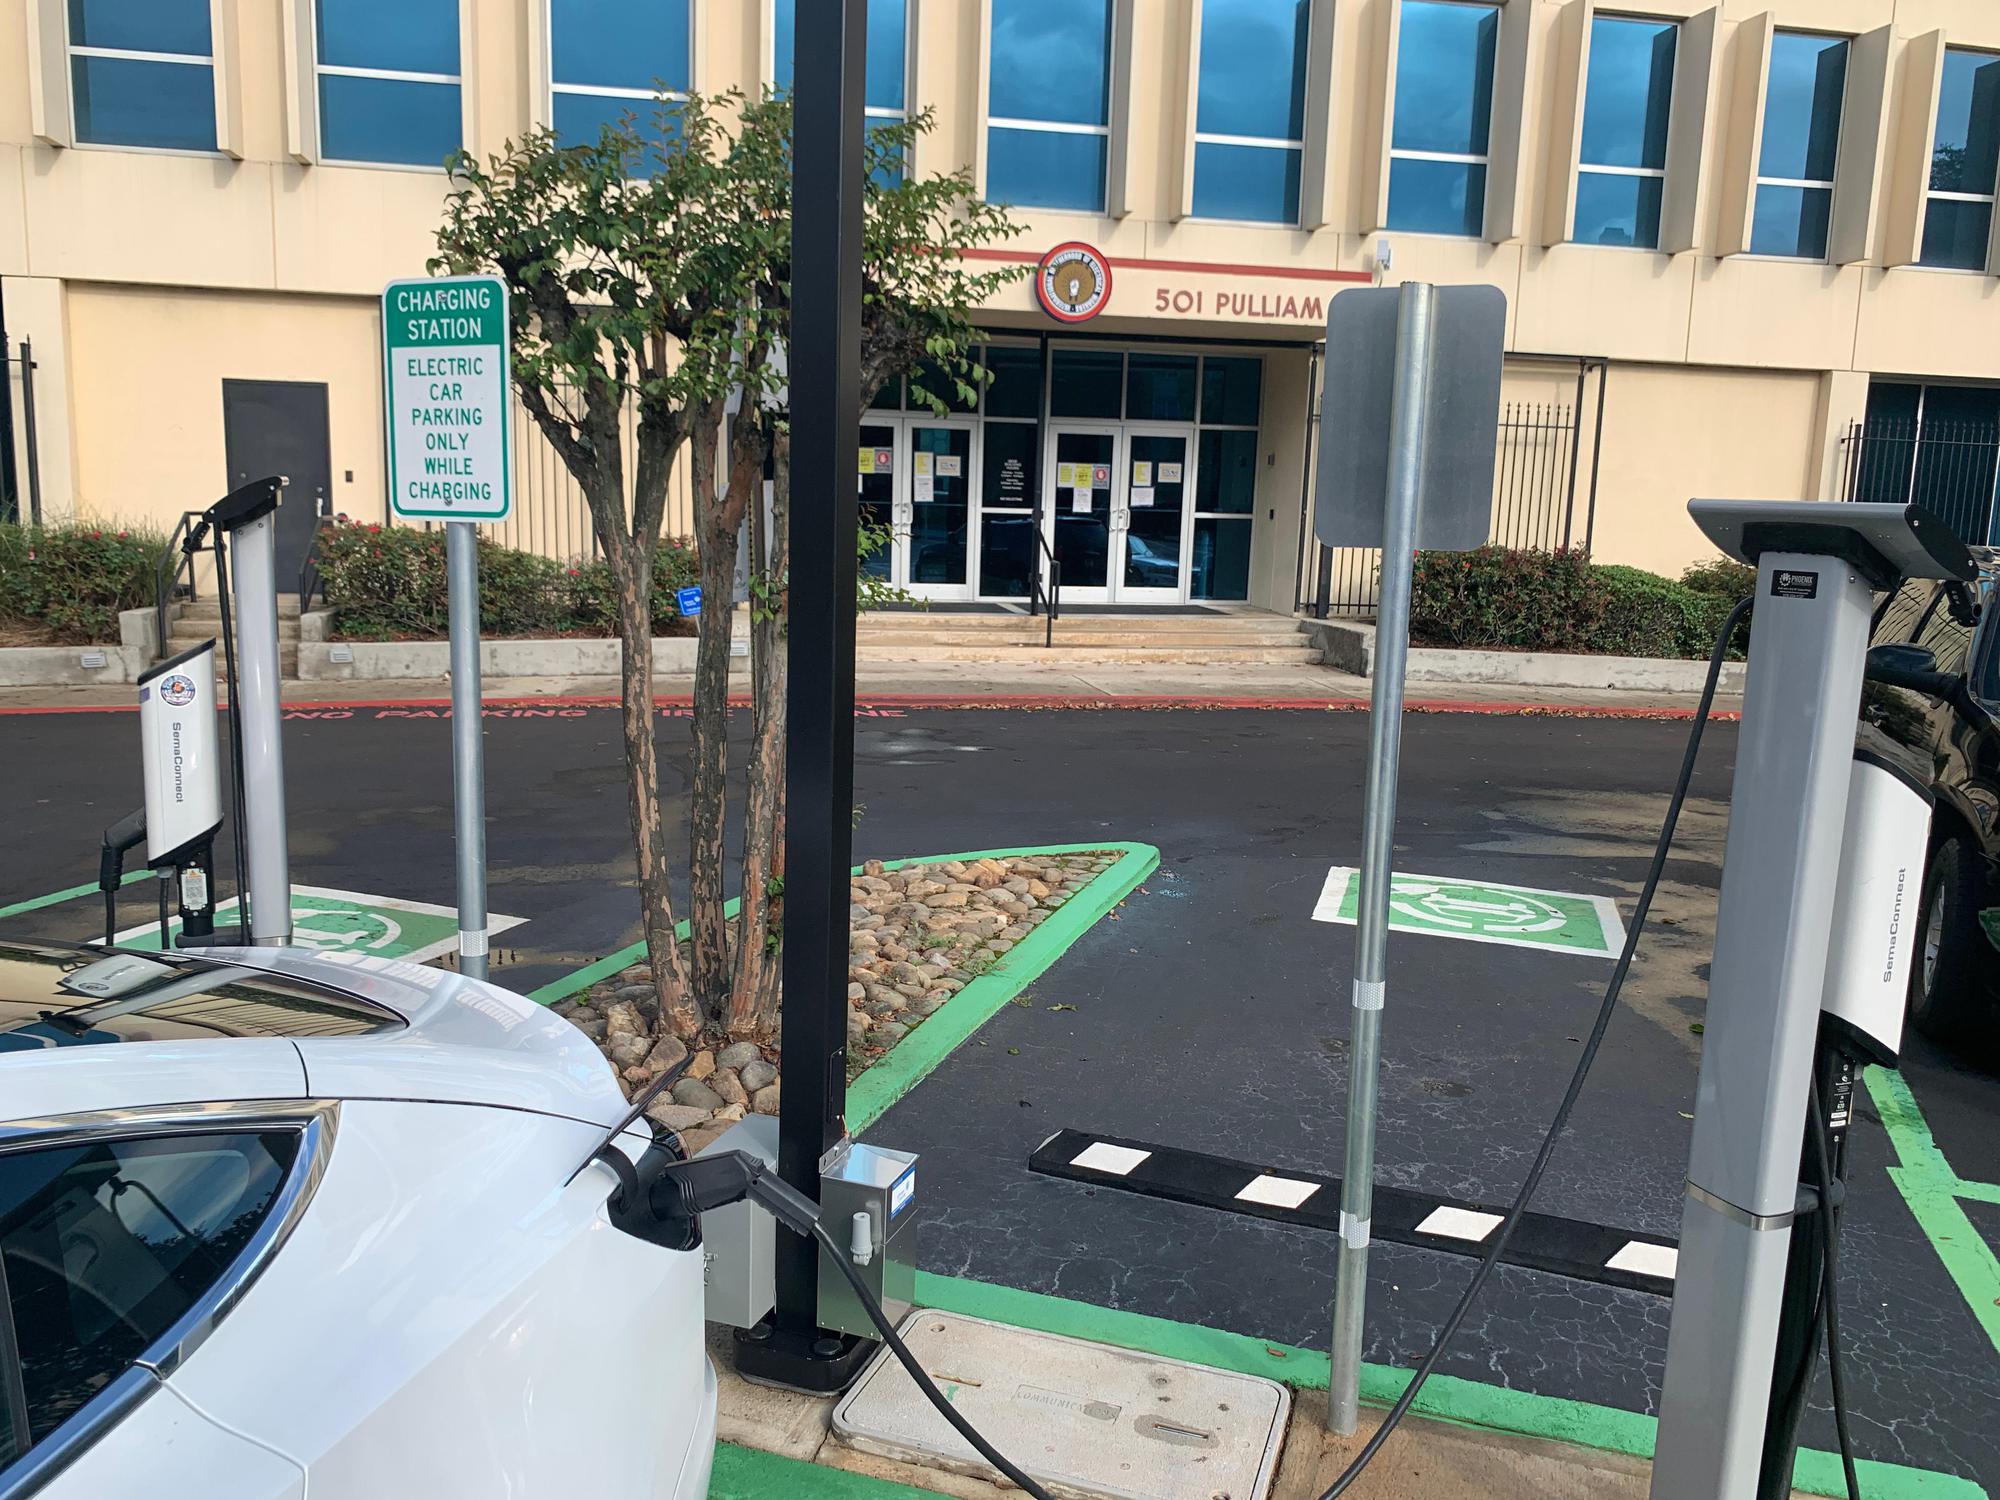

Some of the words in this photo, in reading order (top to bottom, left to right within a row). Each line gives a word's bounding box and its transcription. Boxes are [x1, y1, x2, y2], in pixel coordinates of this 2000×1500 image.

[398, 287, 491, 313] CHARGING
[1155, 288, 1203, 314] 501
[1216, 292, 1323, 319] PULLIAM
[408, 317, 482, 340] STATION
[408, 357, 484, 377] ELECTRIC
[429, 383, 463, 401] CAR
[412, 408, 482, 426] PARKING
[426, 432, 469, 450] ONLY
[424, 457, 473, 475] WHILE
[409, 482, 492, 500] CHARGING
[281, 710, 354, 720] NO
[374, 709, 588, 719] PAKING
[172, 722, 184, 803] SemaConnect
[1883, 867, 1906, 983] SemaConnect
